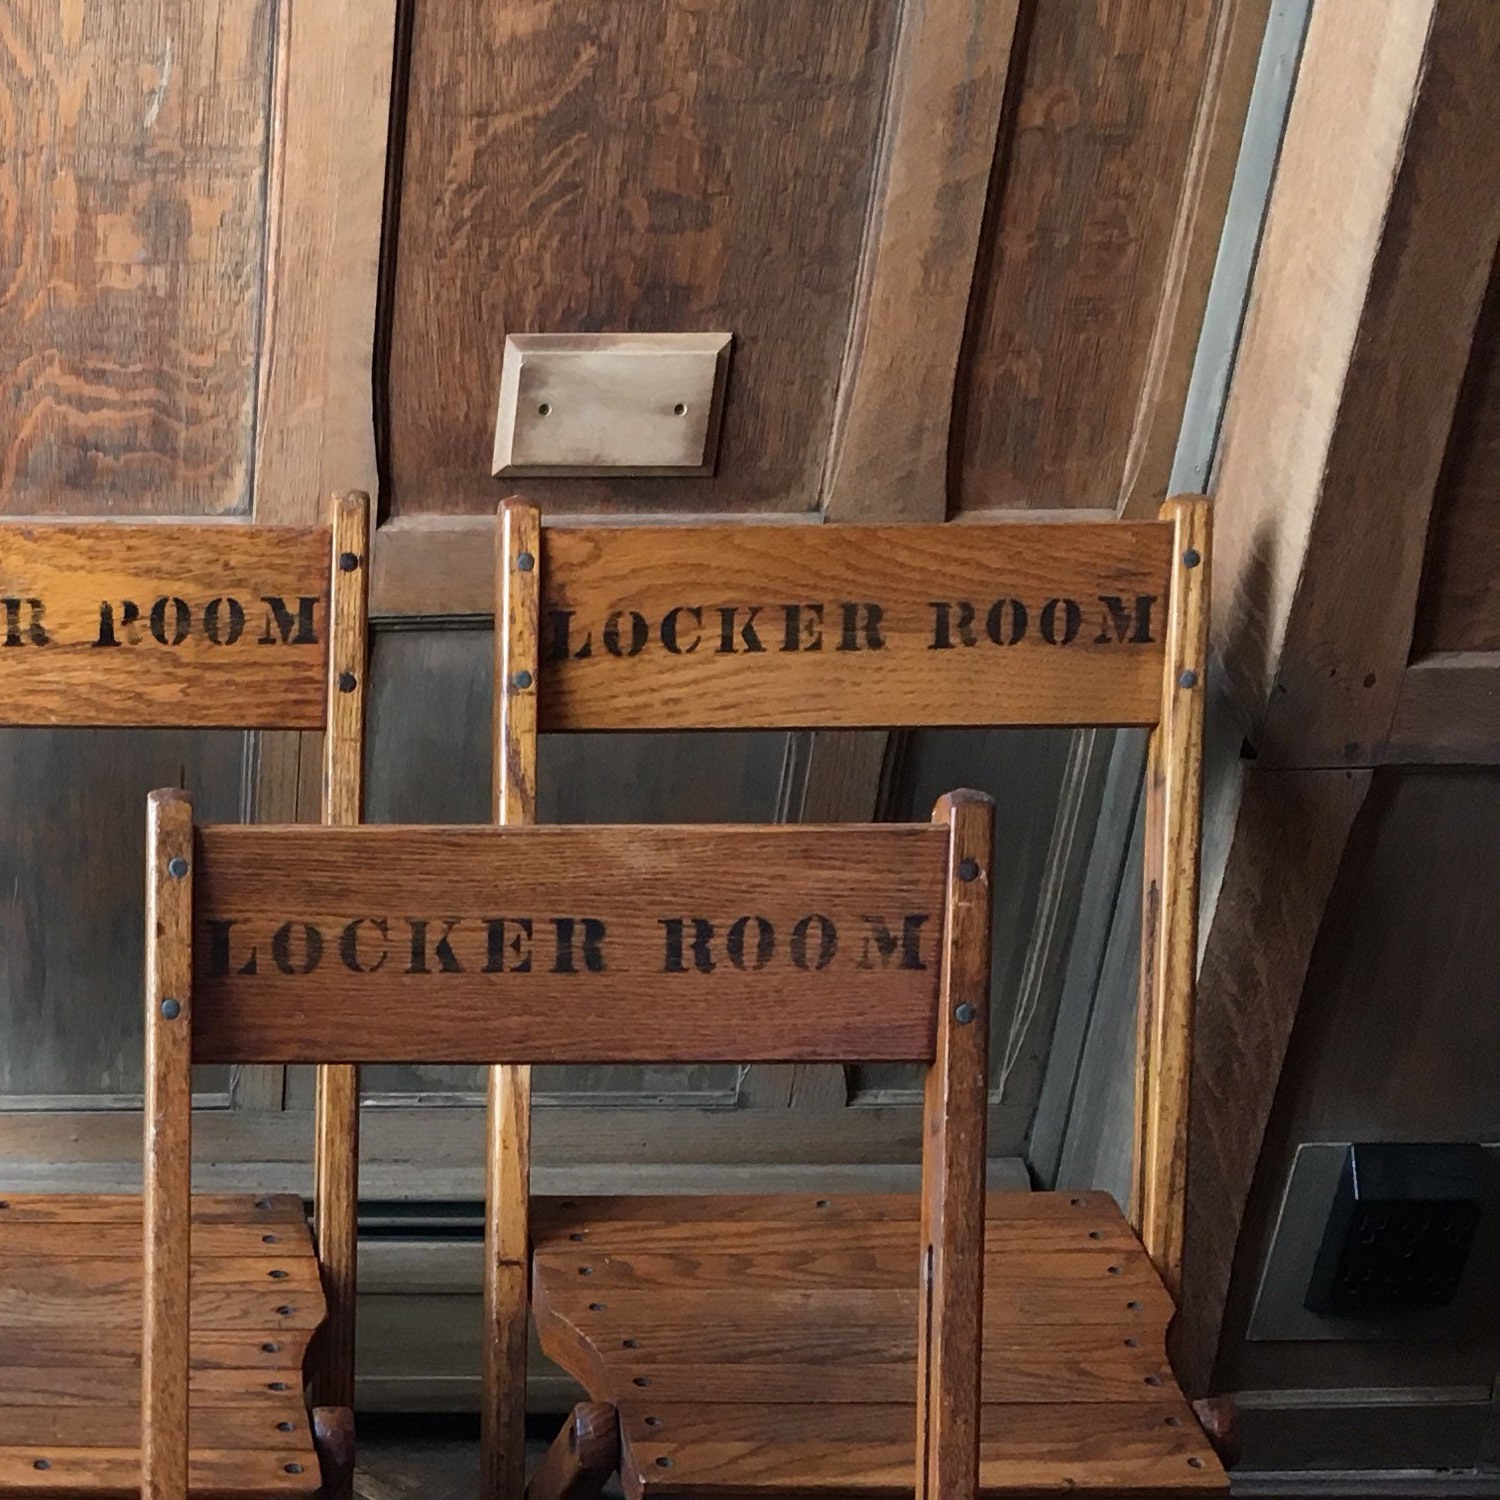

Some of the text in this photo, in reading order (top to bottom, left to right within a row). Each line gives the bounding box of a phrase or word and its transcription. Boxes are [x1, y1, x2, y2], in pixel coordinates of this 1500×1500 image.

[547, 595, 1159, 660] LOCKER ROOM
[205, 913, 928, 976] LOCKER ROOM
